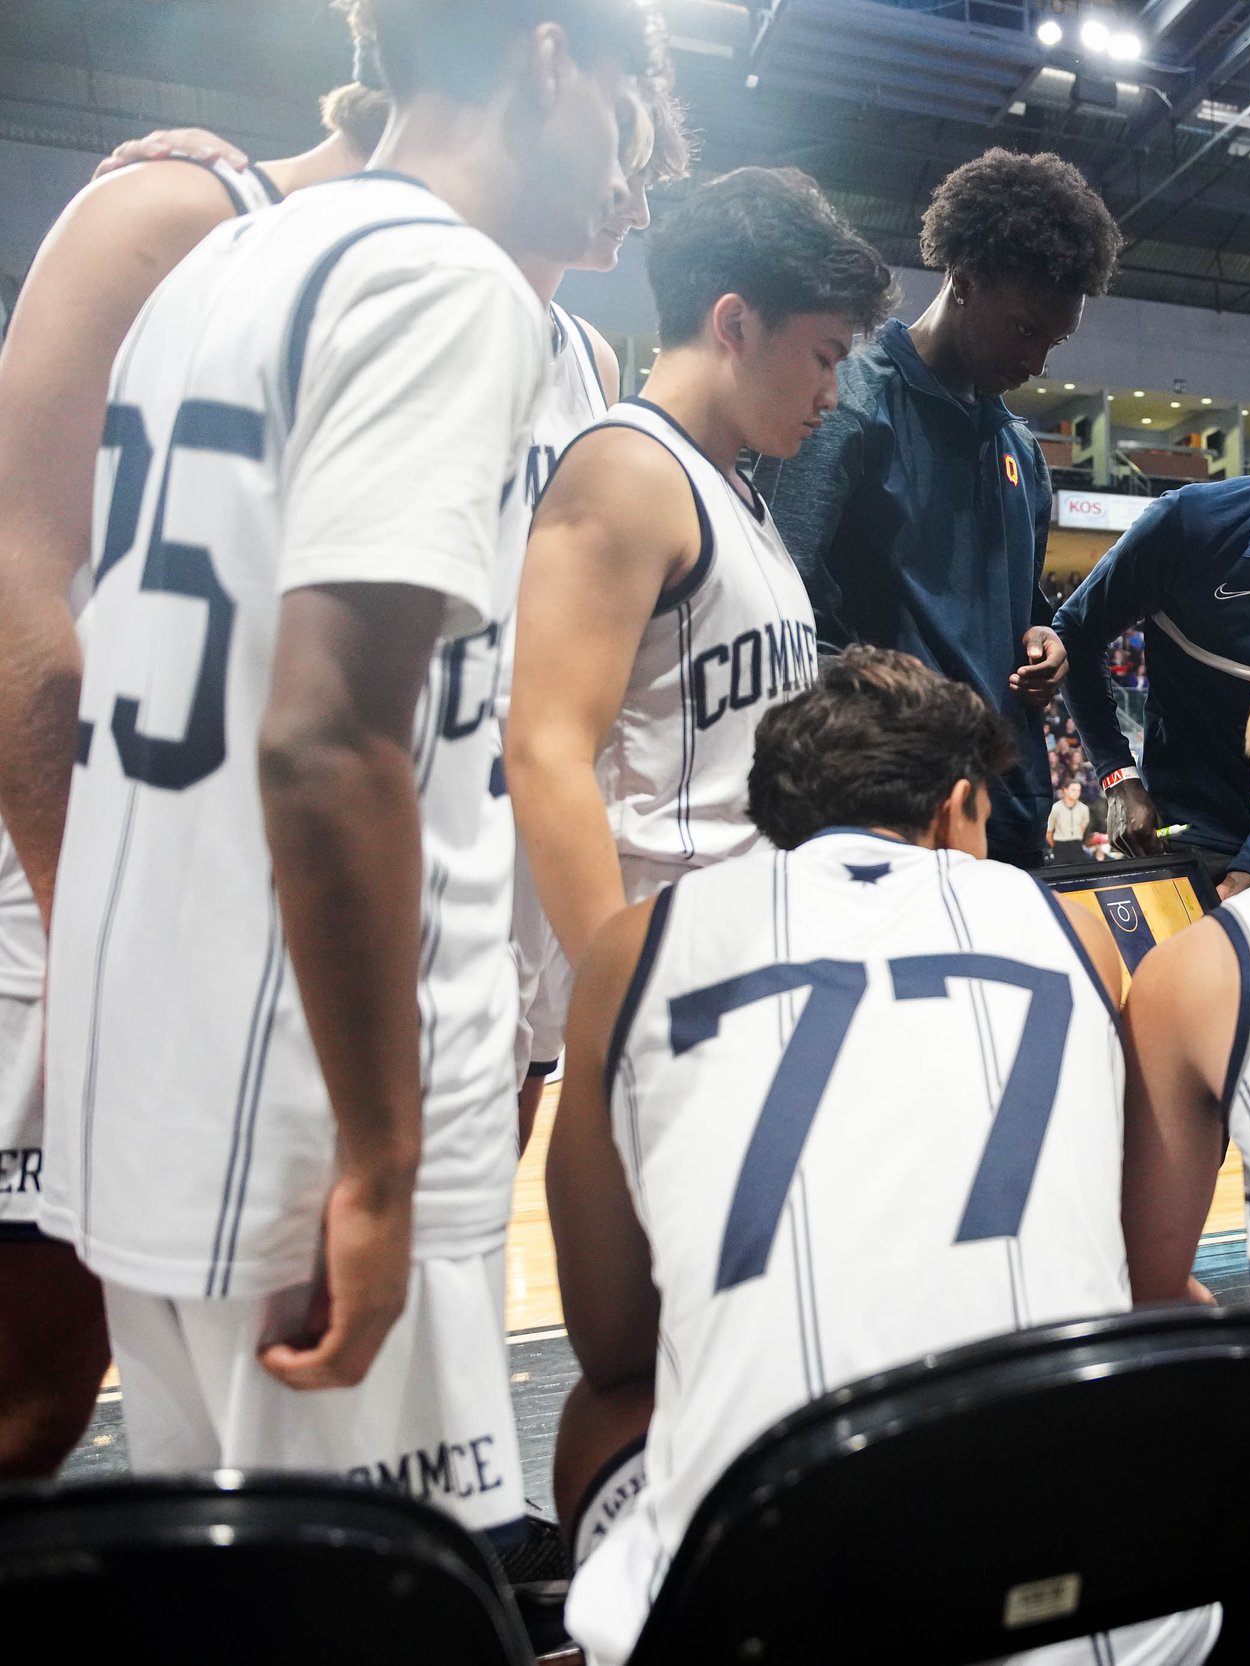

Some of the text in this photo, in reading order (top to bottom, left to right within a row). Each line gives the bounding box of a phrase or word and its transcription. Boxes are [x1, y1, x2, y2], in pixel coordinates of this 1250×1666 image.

[1004, 454, 1019, 487] Q
[1068, 500, 1102, 515] KOS
[668, 952, 1075, 1295] 77
